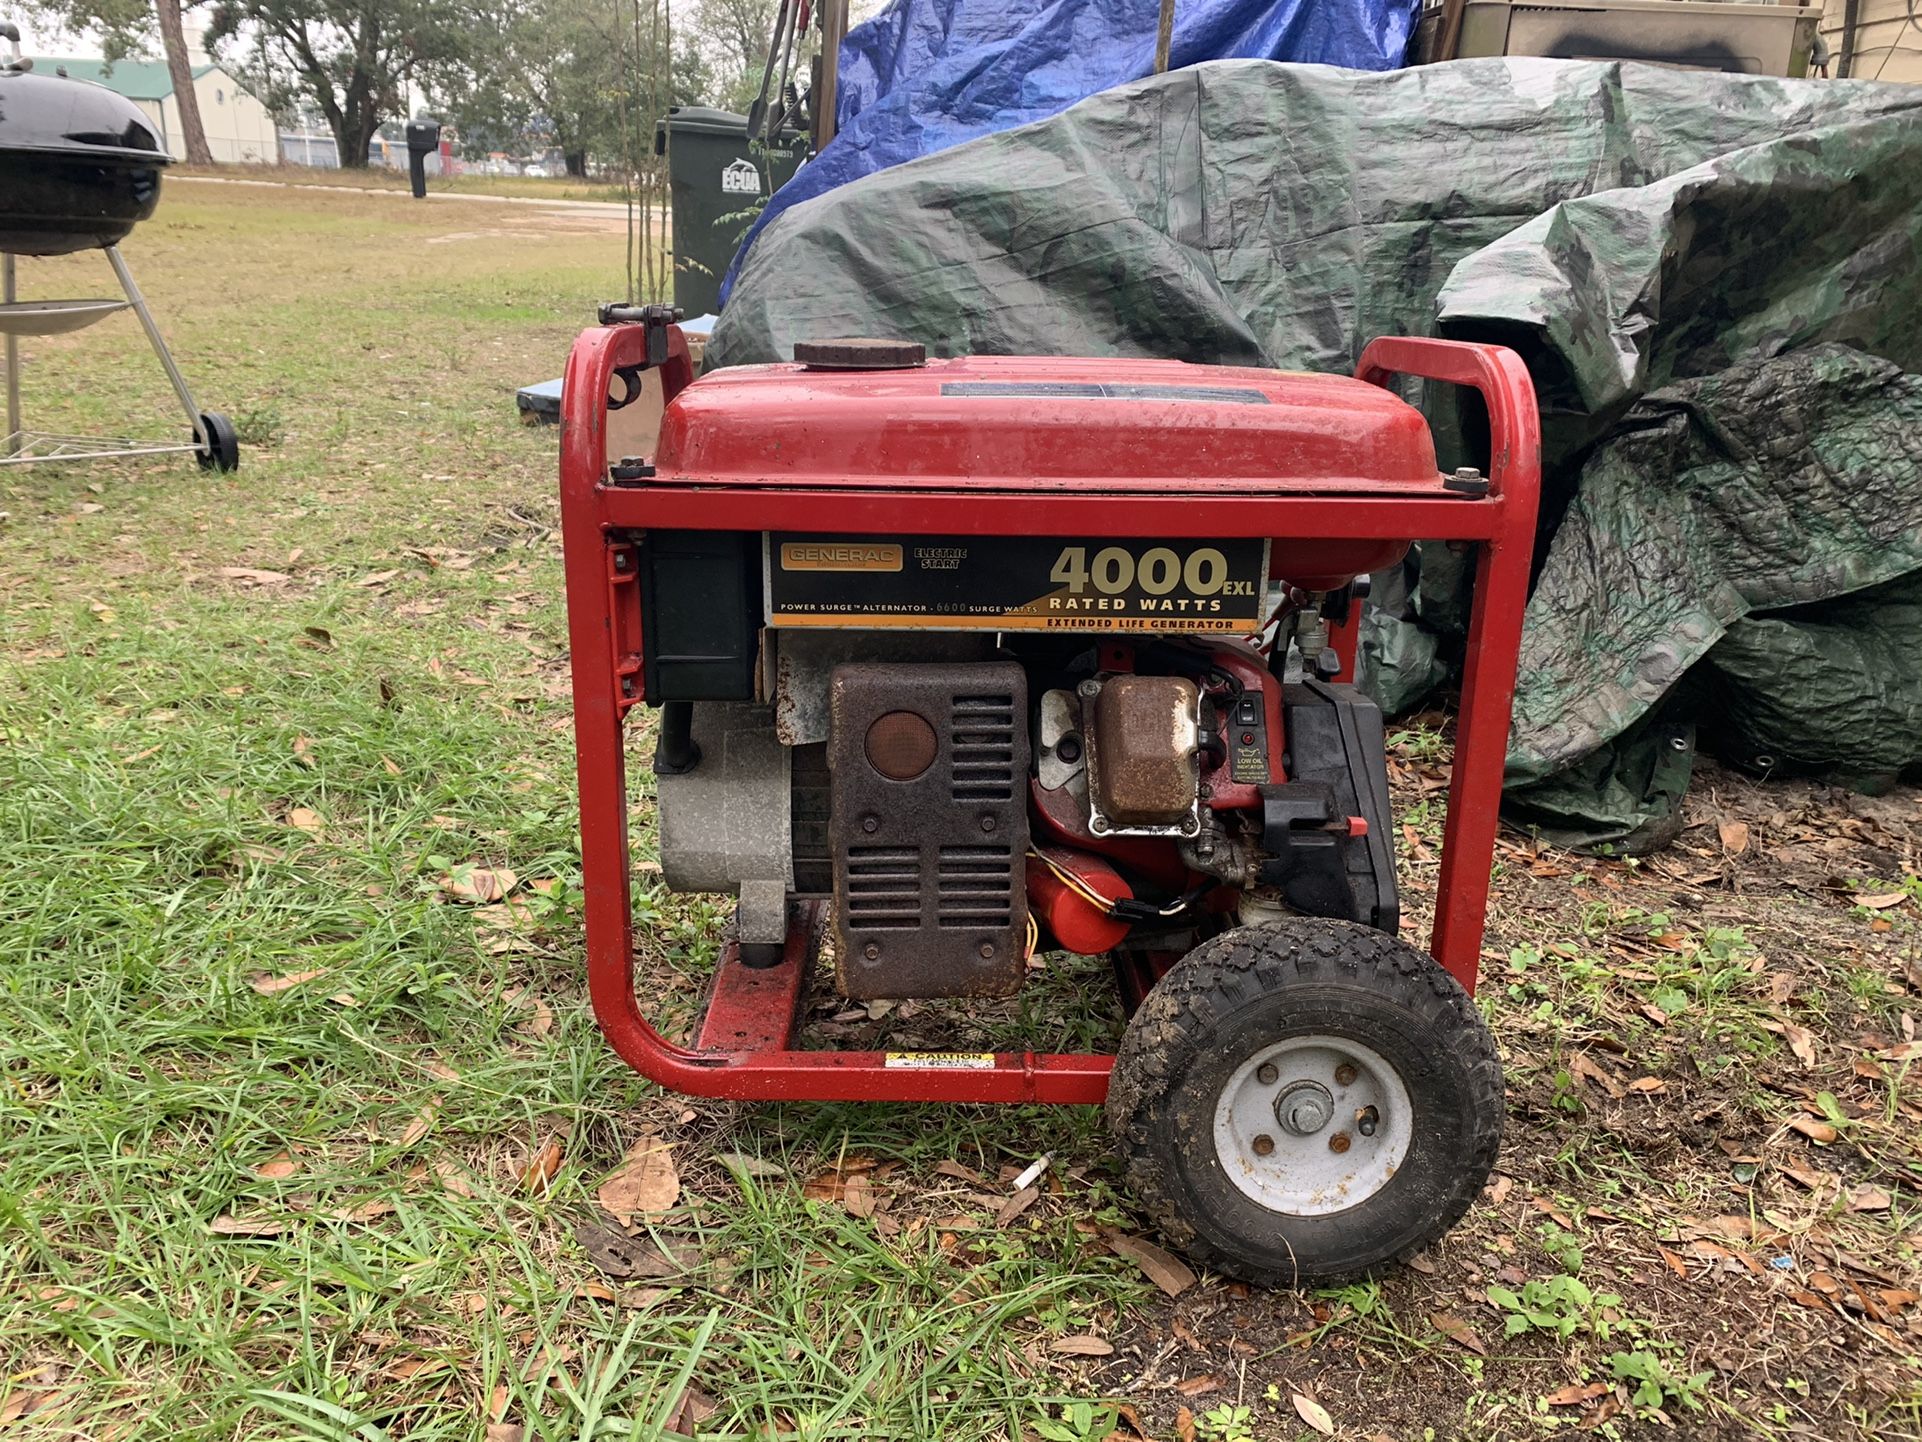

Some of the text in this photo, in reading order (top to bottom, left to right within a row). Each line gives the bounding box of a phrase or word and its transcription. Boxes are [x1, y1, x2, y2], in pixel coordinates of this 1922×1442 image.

[789, 548, 895, 563] GENERAC
[914, 548, 967, 559] ELECTRIC
[921, 559, 961, 569] START
[1050, 546, 1255, 596] 4000 EXL
[780, 603, 816, 611] POWER
[863, 604, 927, 612] ALTERNATOR
[936, 602, 966, 612] 6600
[969, 605, 1001, 613] SURGE
[1049, 597, 1222, 612] RATED WATTS
[1047, 618, 1234, 629] EXTENDED LIFE GENERATOR
